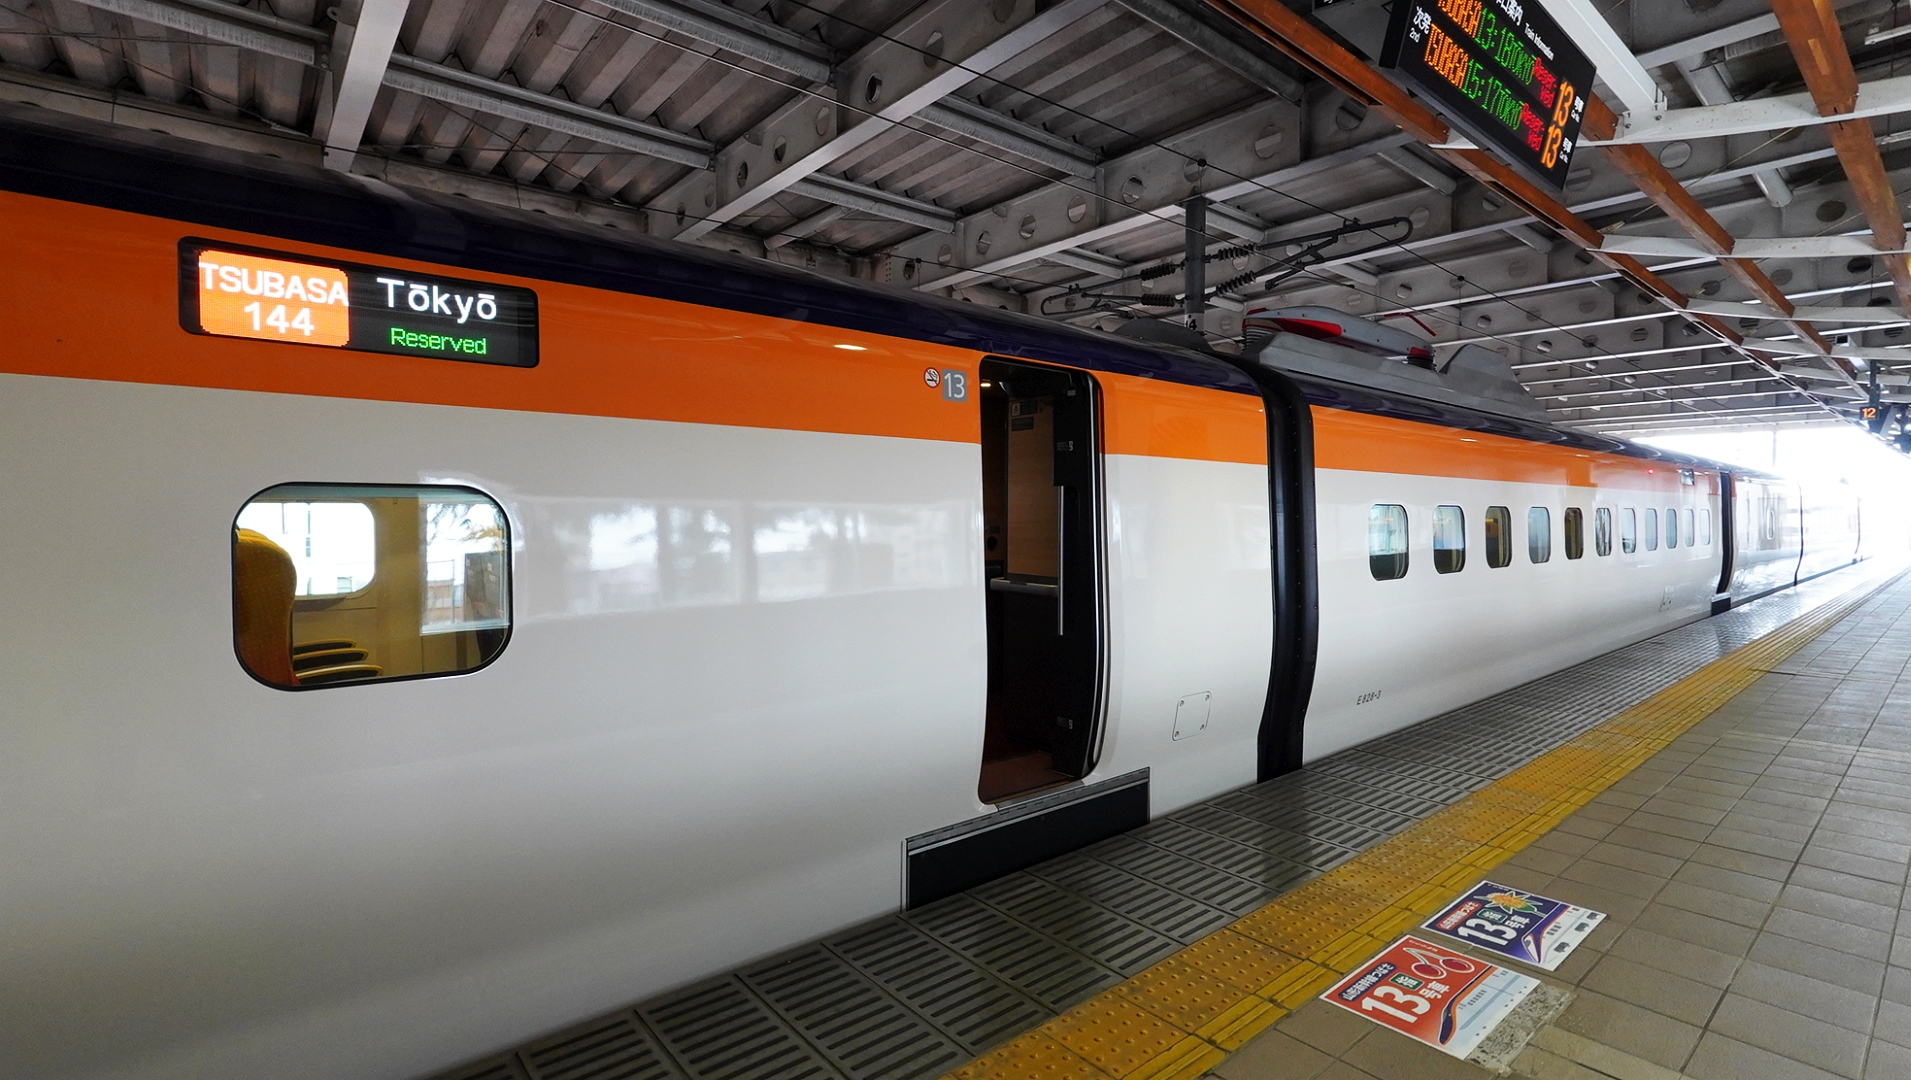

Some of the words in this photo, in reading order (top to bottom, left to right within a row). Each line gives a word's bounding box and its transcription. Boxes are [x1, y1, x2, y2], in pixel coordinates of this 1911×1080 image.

[1409, 27, 1421, 43] 2nd
[1413, 6, 1431, 34] 次発
[1525, 22, 1535, 41] Train
[1534, 33, 1554, 61] Information
[1424, 23, 1468, 89] TSUBASA
[1462, 58, 1502, 114] 15:17
[1542, 124, 1562, 169] 13
[1554, 81, 1574, 126] 13
[198, 262, 349, 306] TSUBASA
[376, 278, 498, 324] Tōkyō
[244, 302, 314, 337] 144
[390, 327, 487, 354] Reserved
[944, 372, 965, 398] 13
[1862, 407, 1876, 418] 12
[1457, 918, 1518, 946] 13
[1504, 915, 1531, 929] 号車
[1361, 985, 1431, 1024] 13
[1419, 980, 1451, 999] 号車
